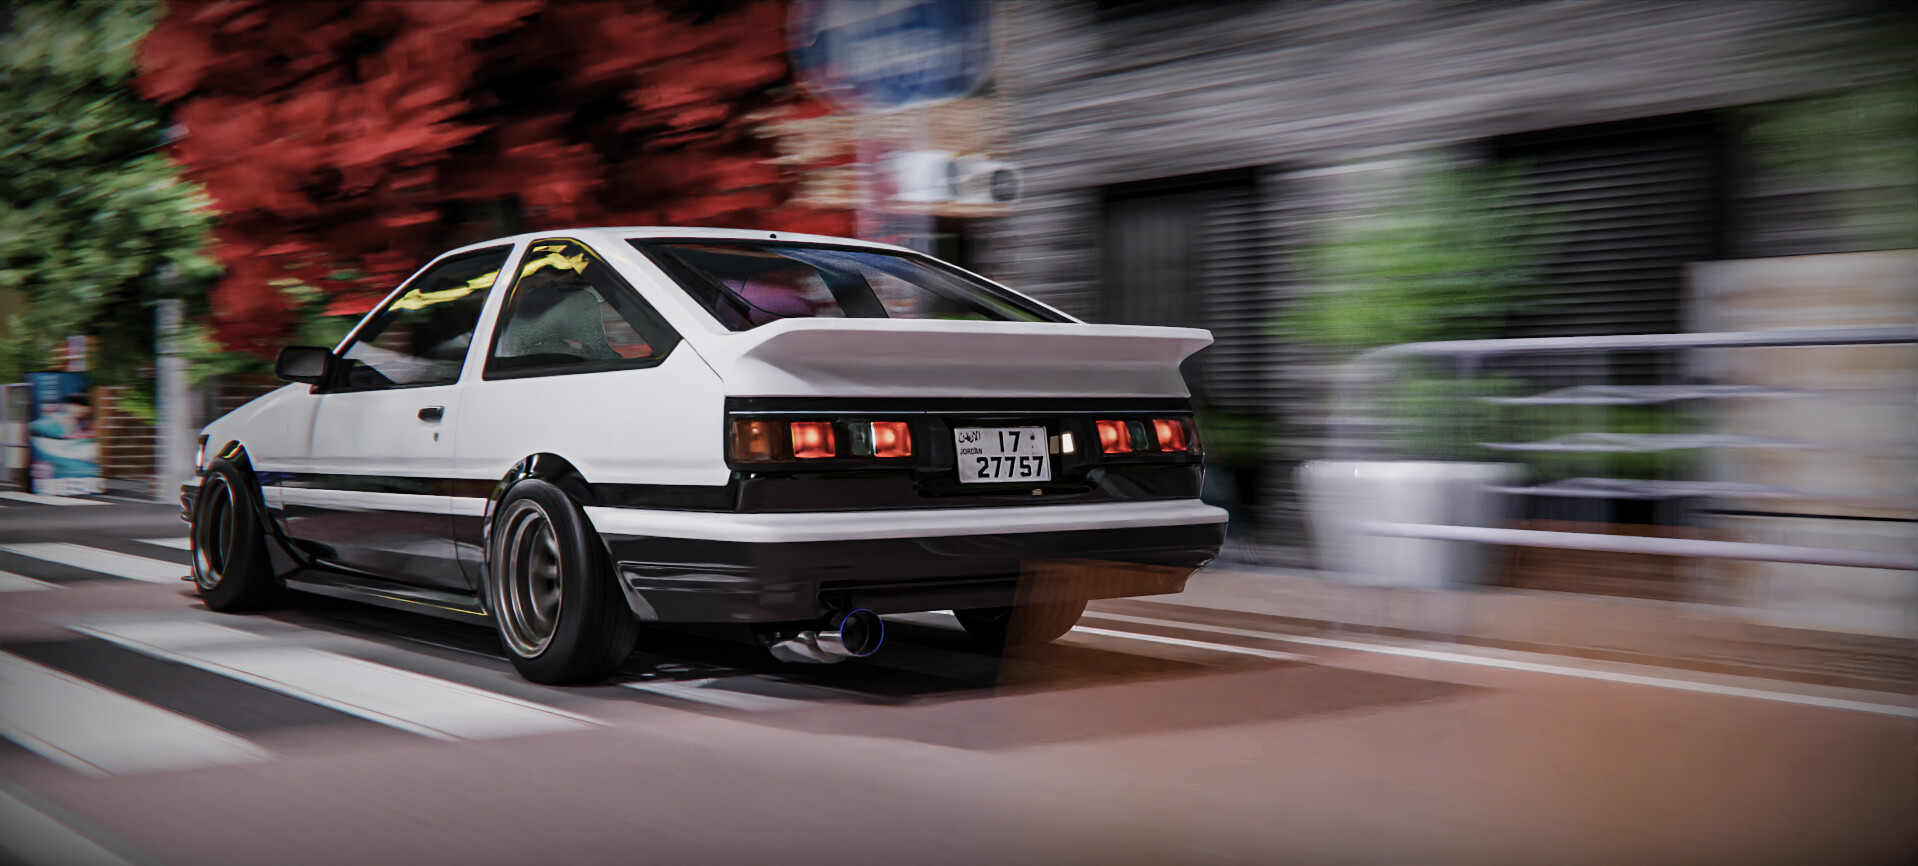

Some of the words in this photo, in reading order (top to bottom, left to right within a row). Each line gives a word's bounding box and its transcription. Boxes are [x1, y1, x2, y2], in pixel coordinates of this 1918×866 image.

[960, 447, 983, 455] JORDAN
[998, 431, 1021, 453] 17
[976, 456, 1044, 478] 27757
